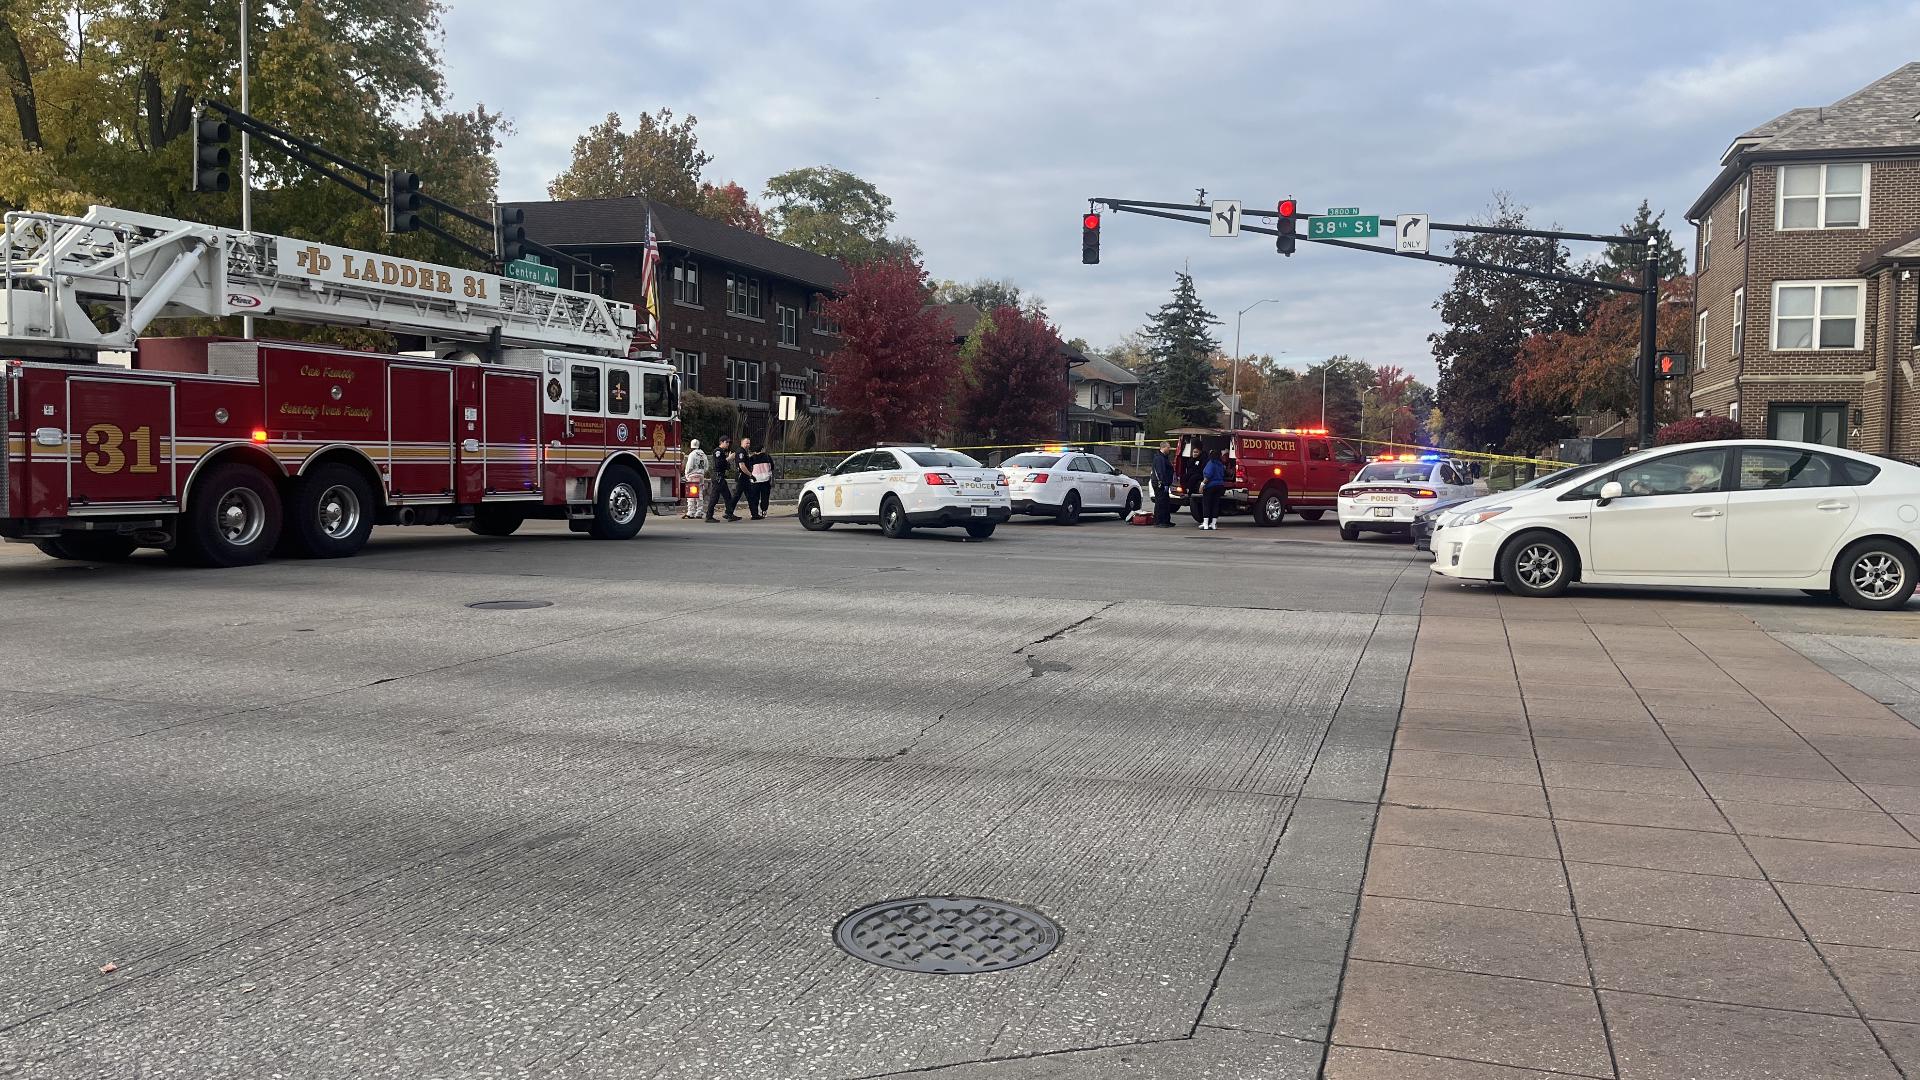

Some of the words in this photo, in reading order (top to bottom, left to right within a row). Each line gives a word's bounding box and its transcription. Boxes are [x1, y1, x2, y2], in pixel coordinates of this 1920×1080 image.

[1354, 220, 1372, 233] St
[1402, 240, 1421, 249] ONLY
[342, 254, 453, 294] LADDER
[463, 275, 488, 300] 31
[508, 263, 540, 281] Central
[544, 271, 555, 284] Av
[85, 423, 158, 474] 31
[1242, 438, 1262, 449] EDO
[1264, 439, 1296, 451] NORTH
[965, 482, 991, 490] POLICE
